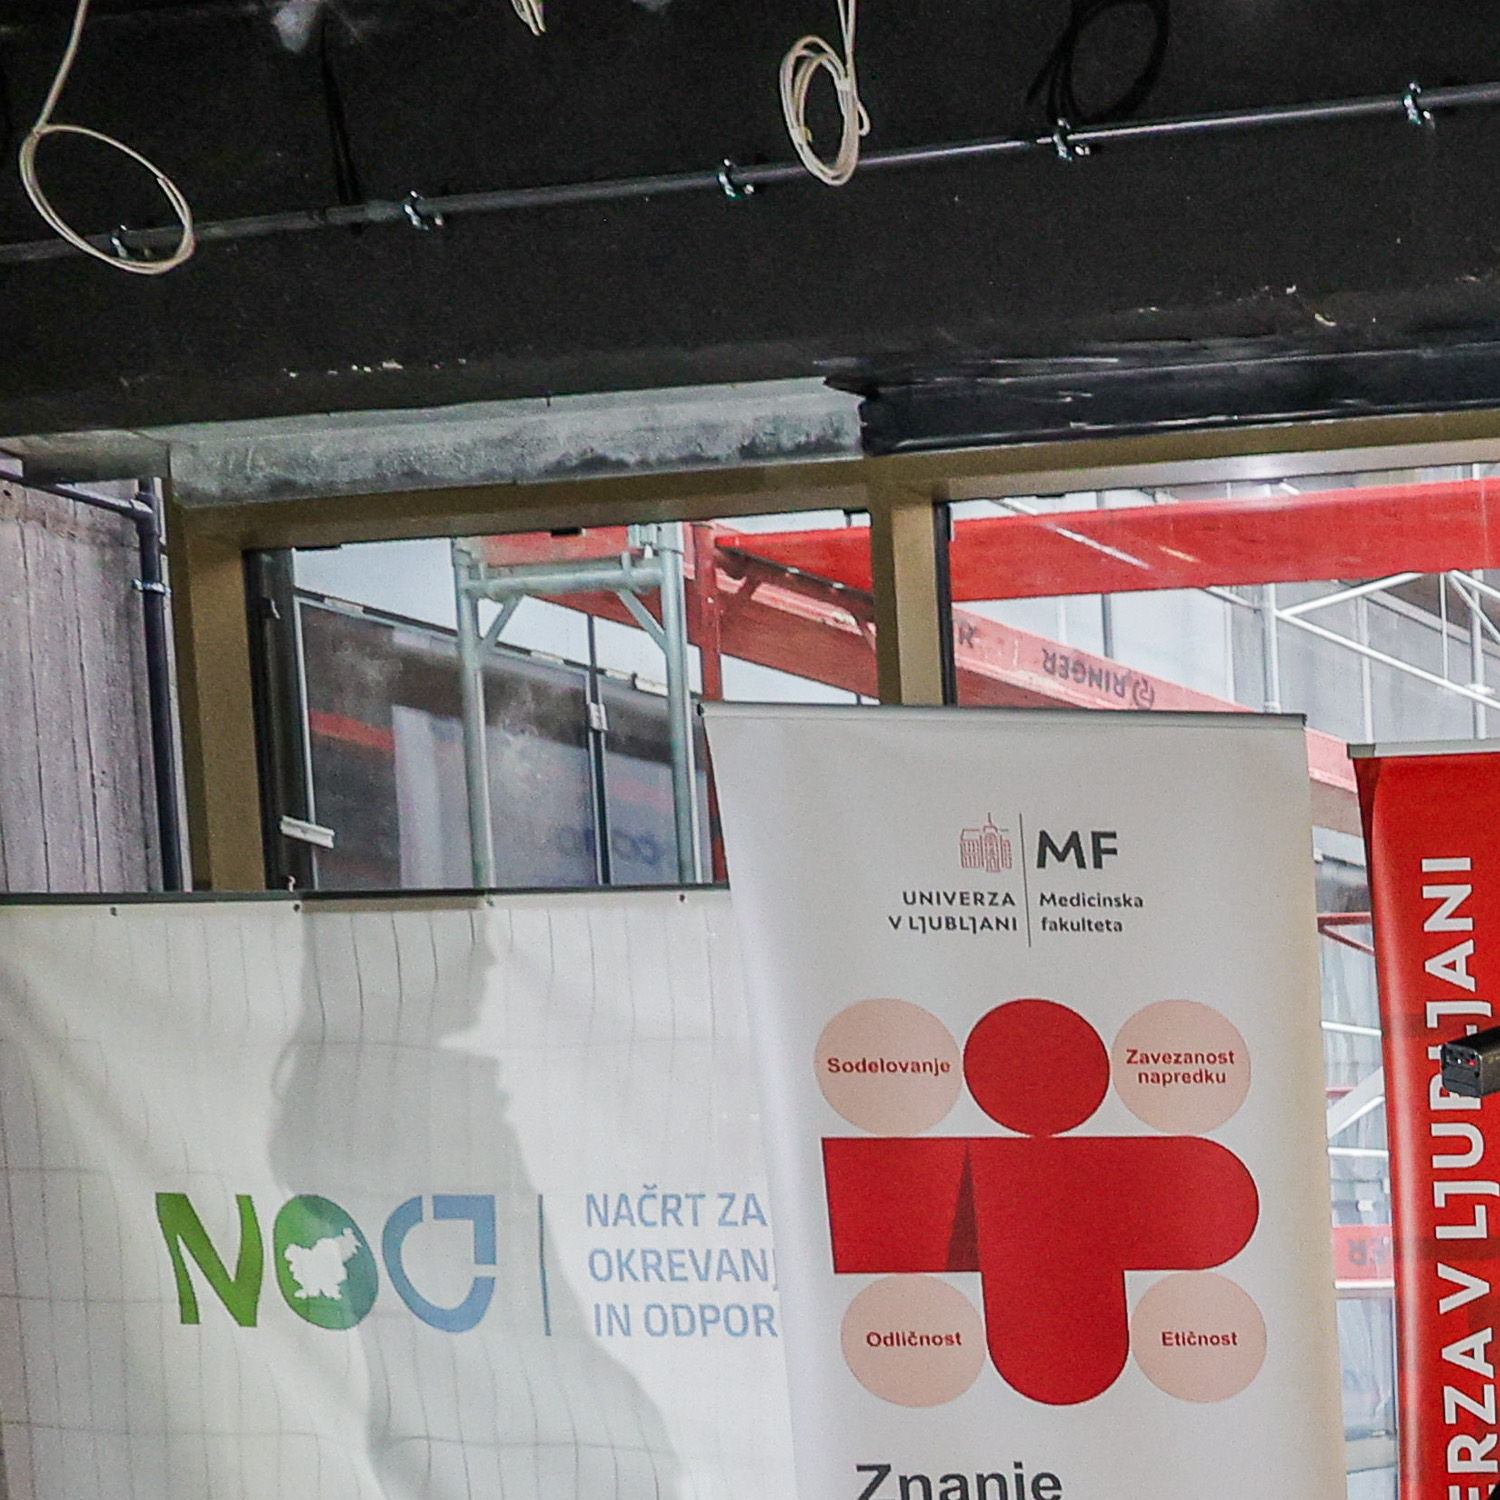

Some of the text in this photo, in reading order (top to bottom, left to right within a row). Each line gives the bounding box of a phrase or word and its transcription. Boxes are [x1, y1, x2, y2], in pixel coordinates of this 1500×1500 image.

[1036, 830, 1118, 869] MF
[903, 891, 1016, 907] UNIVERZA
[1039, 891, 1144, 908] Medicinska
[888, 916, 1018, 934] V LJUBLJANI
[1041, 916, 1123, 933] fakulteta
[1126, 1049, 1235, 1066] Zavezanost
[826, 1058, 951, 1076] Sodelovanje
[1137, 1068, 1227, 1087] napredku
[586, 1184, 768, 1228] NAČRT ZA
[588, 1248, 778, 1291] OKREVAN
[1437, 1262, 1491, 1314] V
[594, 1303, 632, 1337] IN
[866, 1330, 962, 1347] Odličnost
[1162, 1330, 1238, 1347] Etičnost
